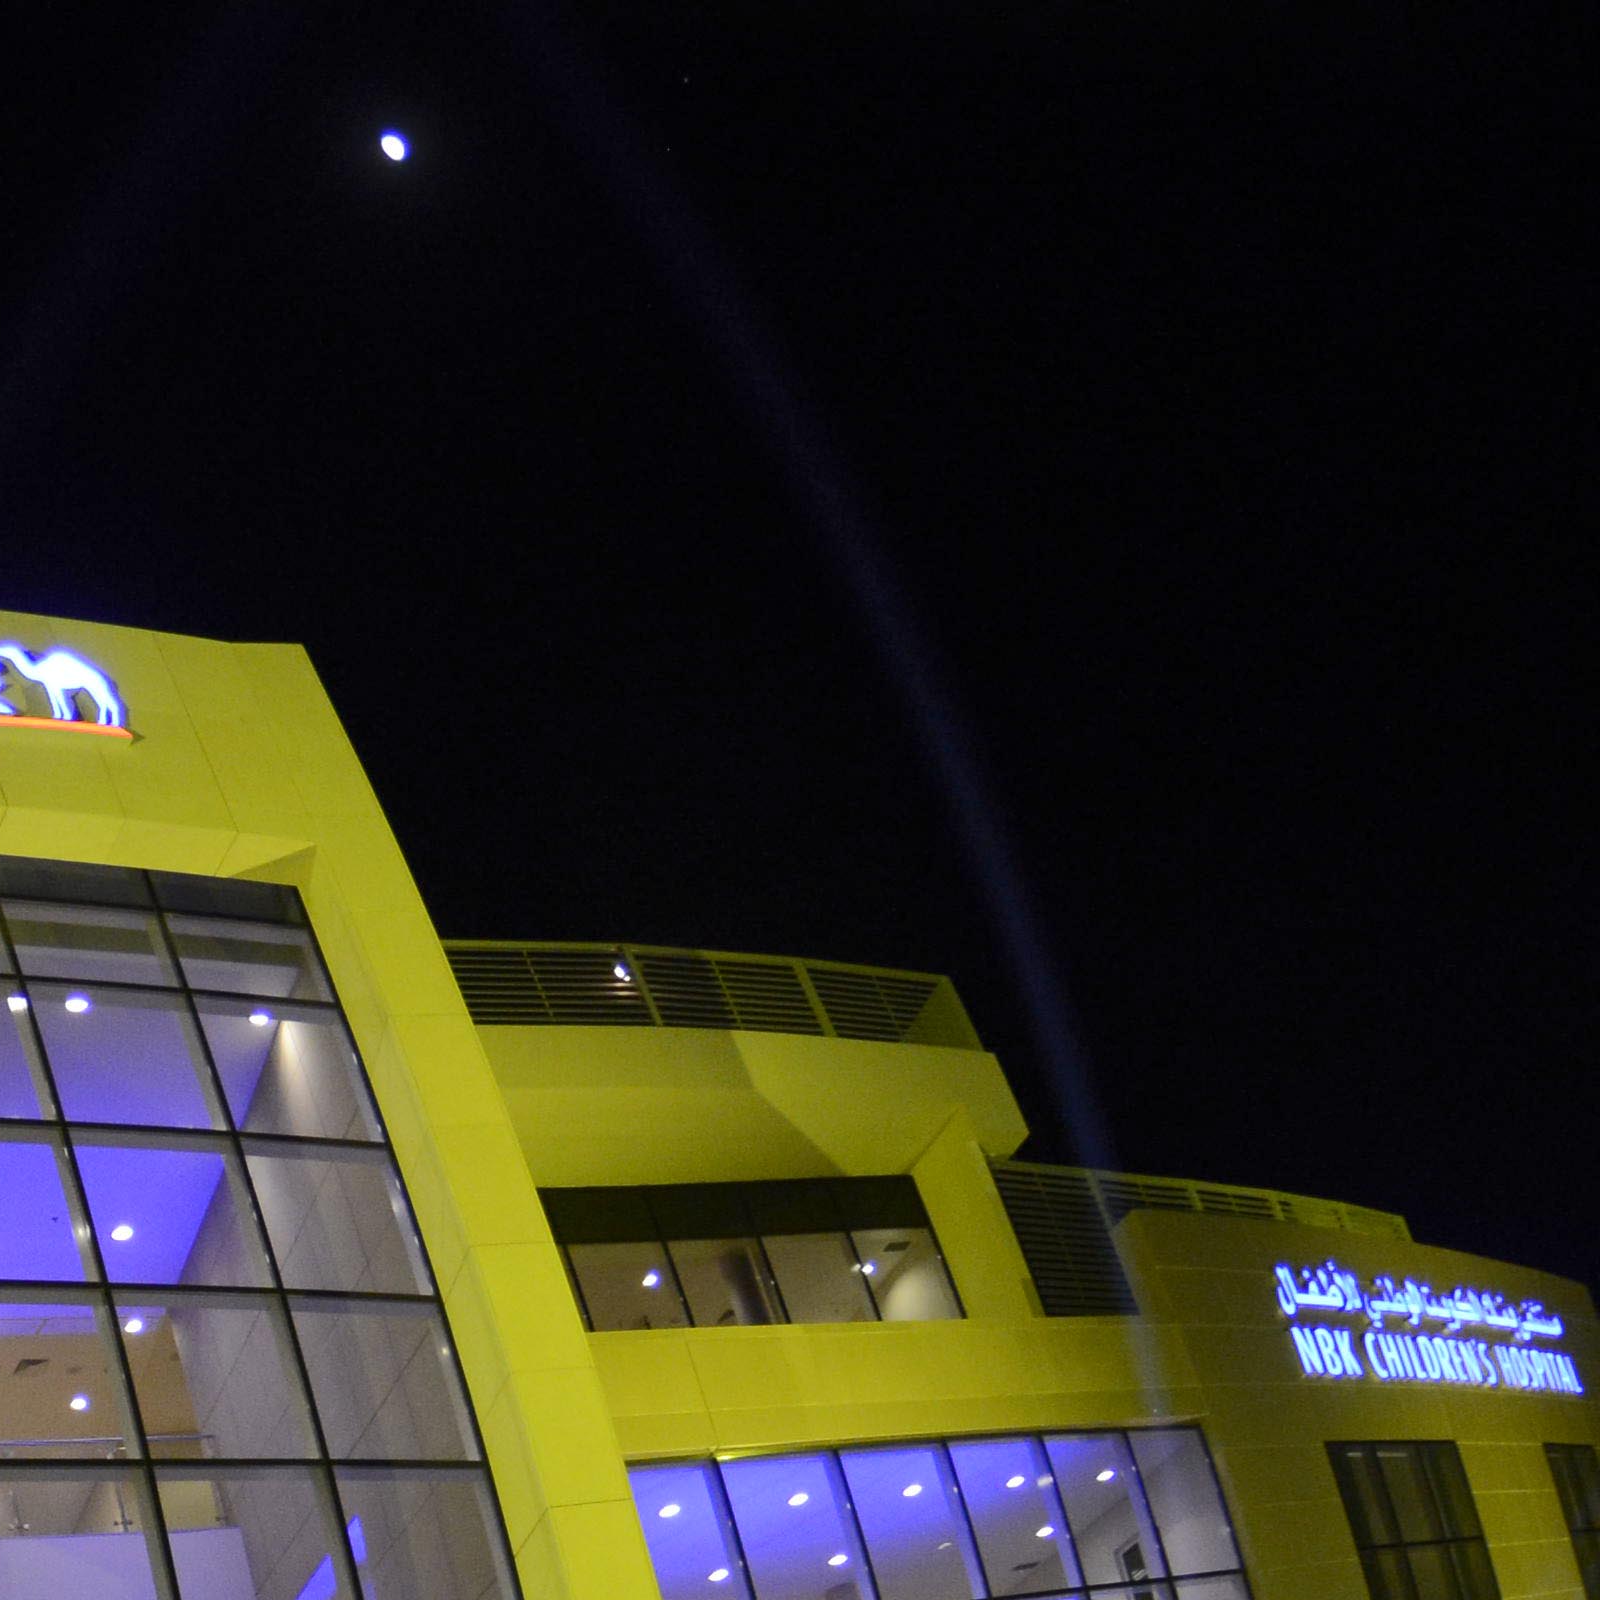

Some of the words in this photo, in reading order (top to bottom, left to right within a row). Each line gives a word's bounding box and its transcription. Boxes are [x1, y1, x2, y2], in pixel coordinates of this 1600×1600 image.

[1290, 1325, 1365, 1378] NBK
[1364, 1331, 1498, 1387] CHILDREN'S
[1493, 1344, 1585, 1394] HOSPITAL
